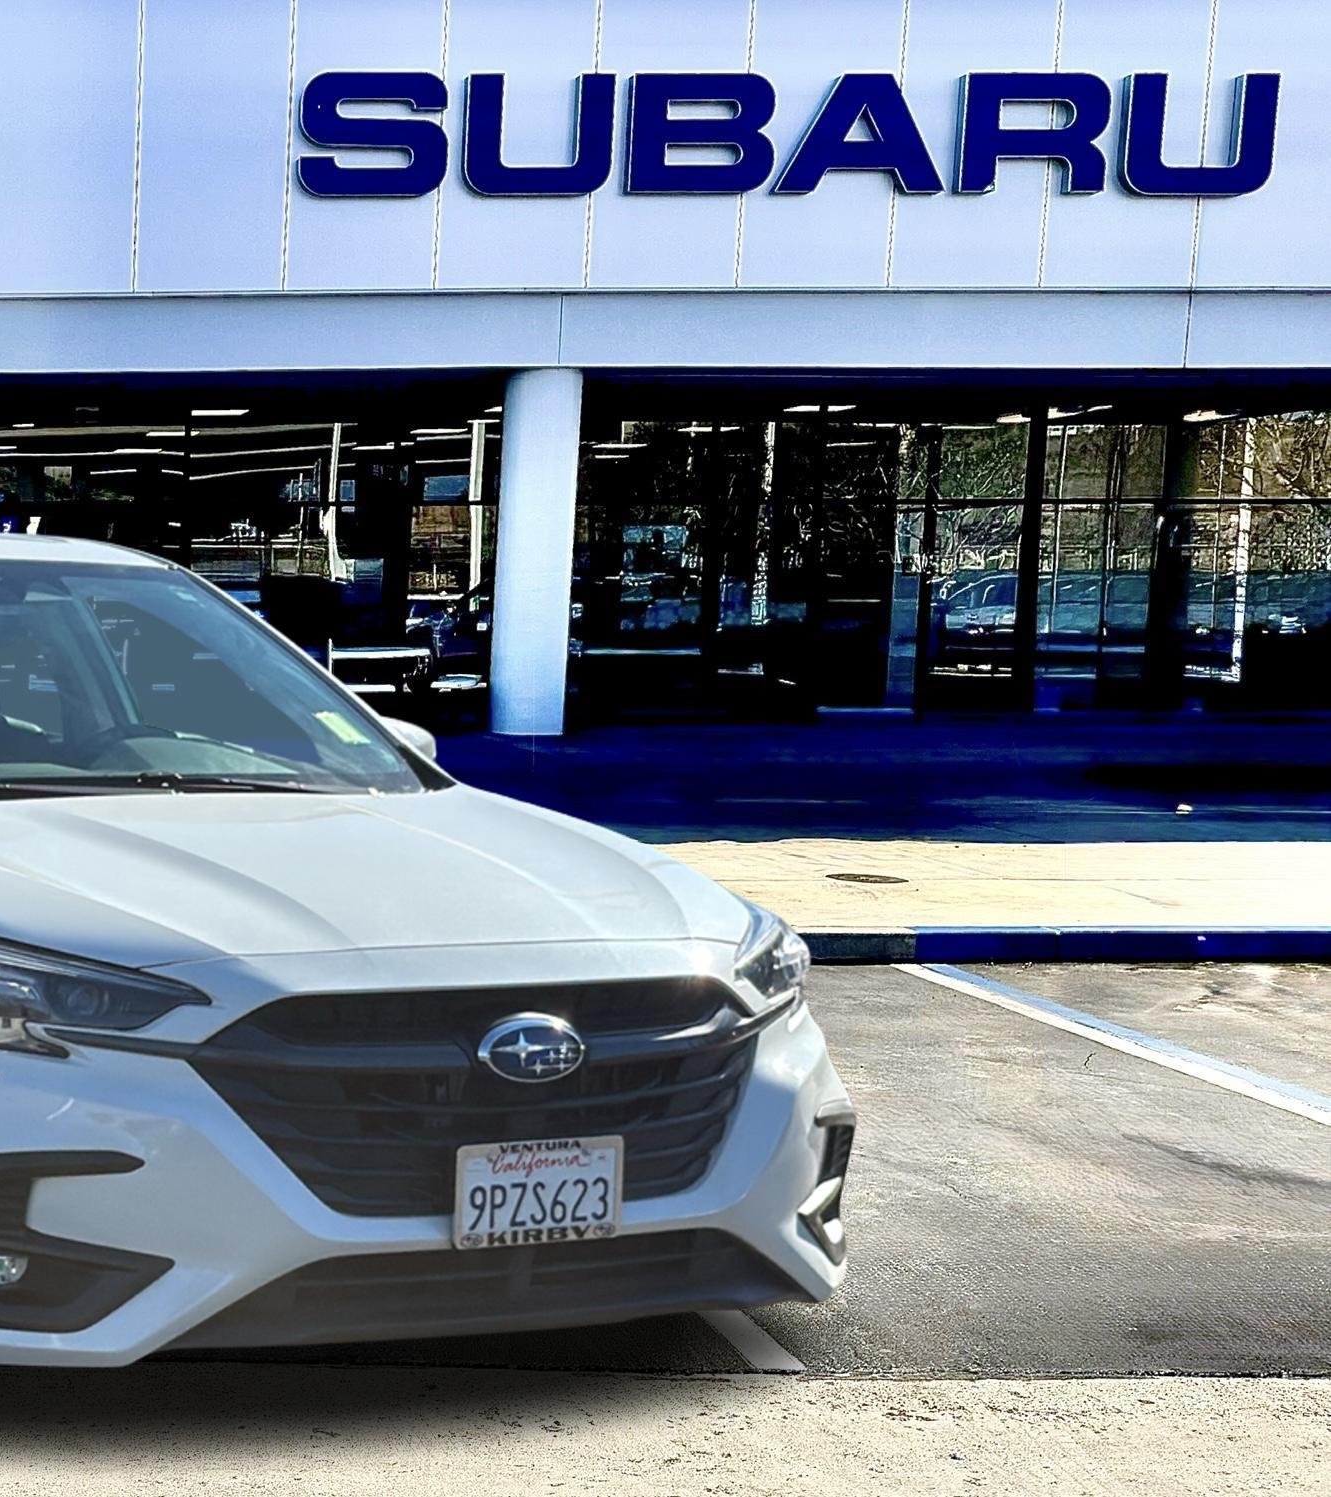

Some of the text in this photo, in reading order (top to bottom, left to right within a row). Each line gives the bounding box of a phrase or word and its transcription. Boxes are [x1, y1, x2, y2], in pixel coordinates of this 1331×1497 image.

[298, 70, 1278, 198] SUBARU
[499, 1140, 582, 1154] VENTURA
[491, 1153, 591, 1178] California
[468, 1176, 609, 1231] 9PZS623
[487, 1224, 591, 1246] KIRBY
